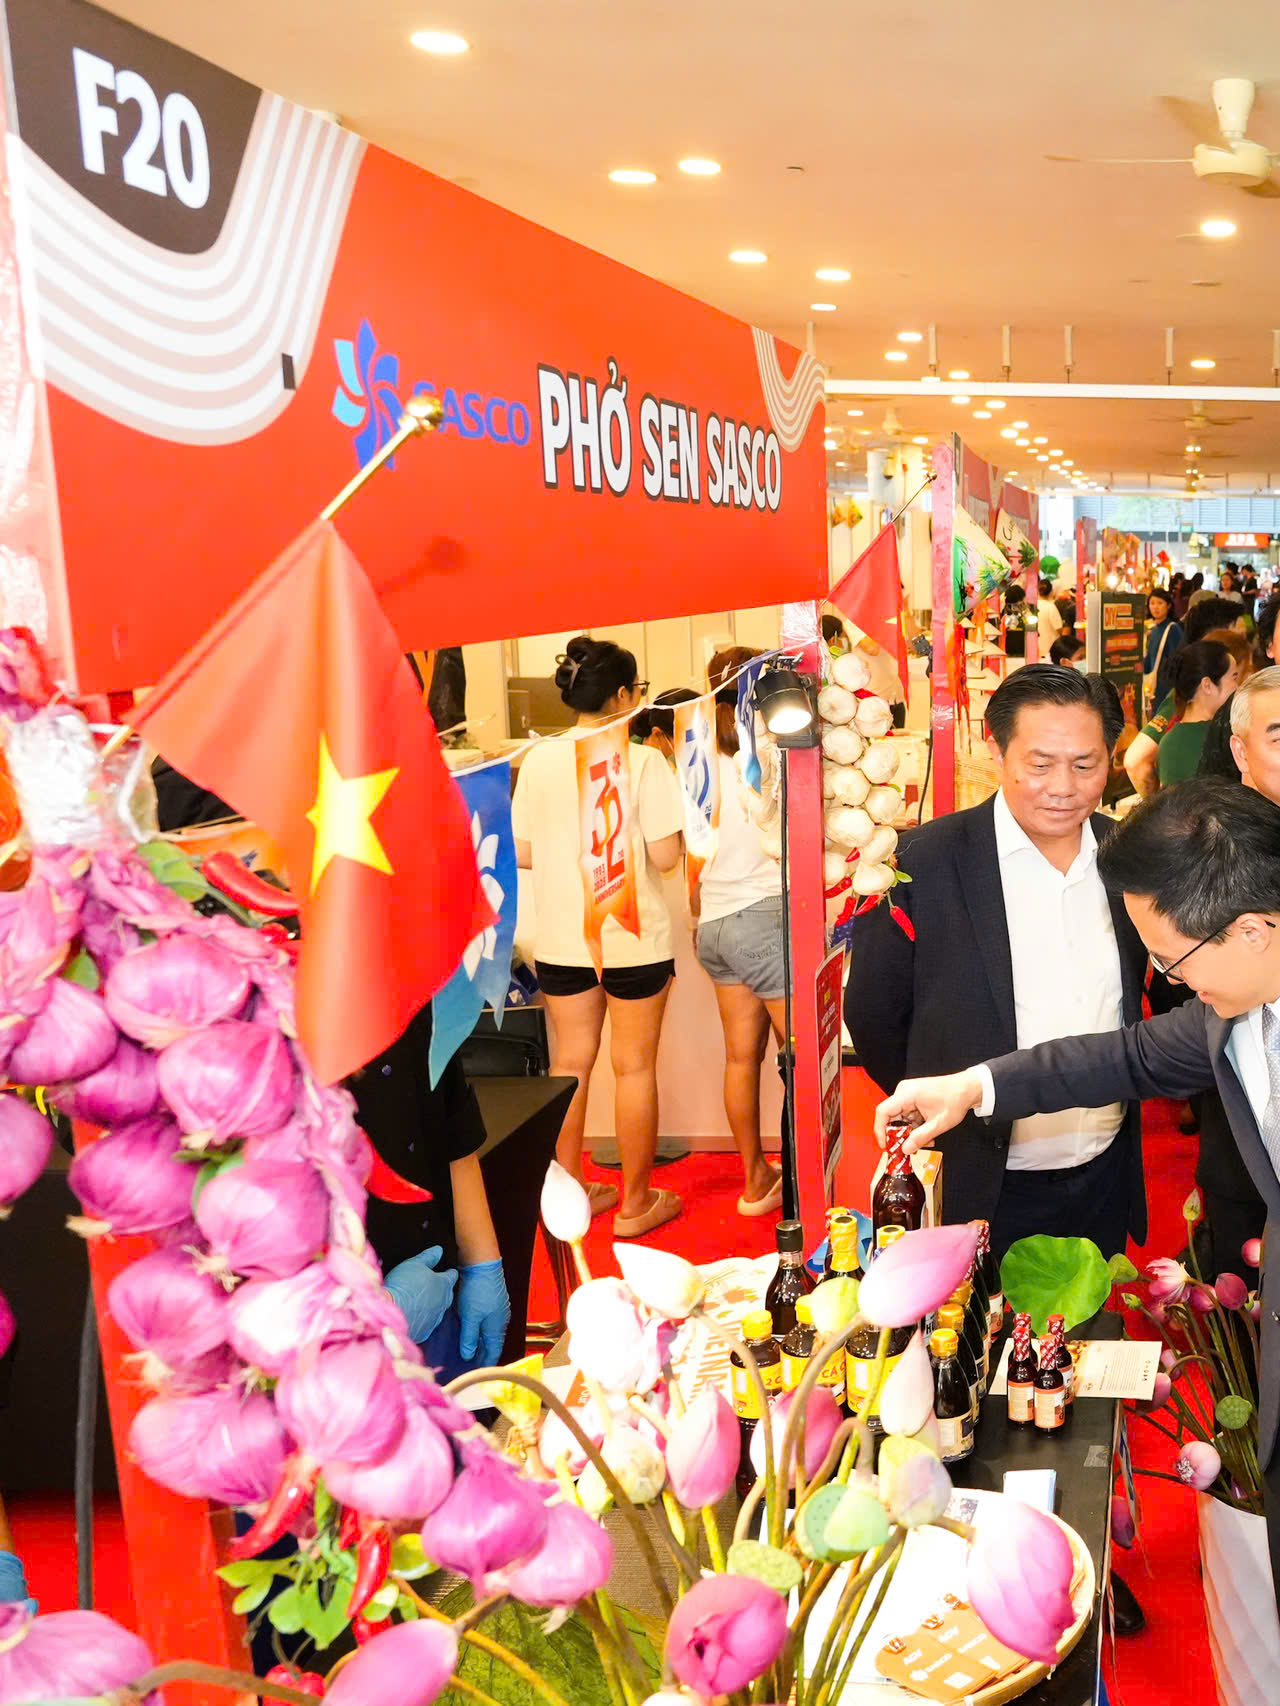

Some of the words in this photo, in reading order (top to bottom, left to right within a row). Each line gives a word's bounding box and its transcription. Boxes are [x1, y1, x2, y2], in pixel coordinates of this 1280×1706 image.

[72, 47, 211, 209] F20
[537, 356, 632, 497] PHỞ
[640, 392, 700, 504] SEN
[706, 411, 782, 513] SASCO
